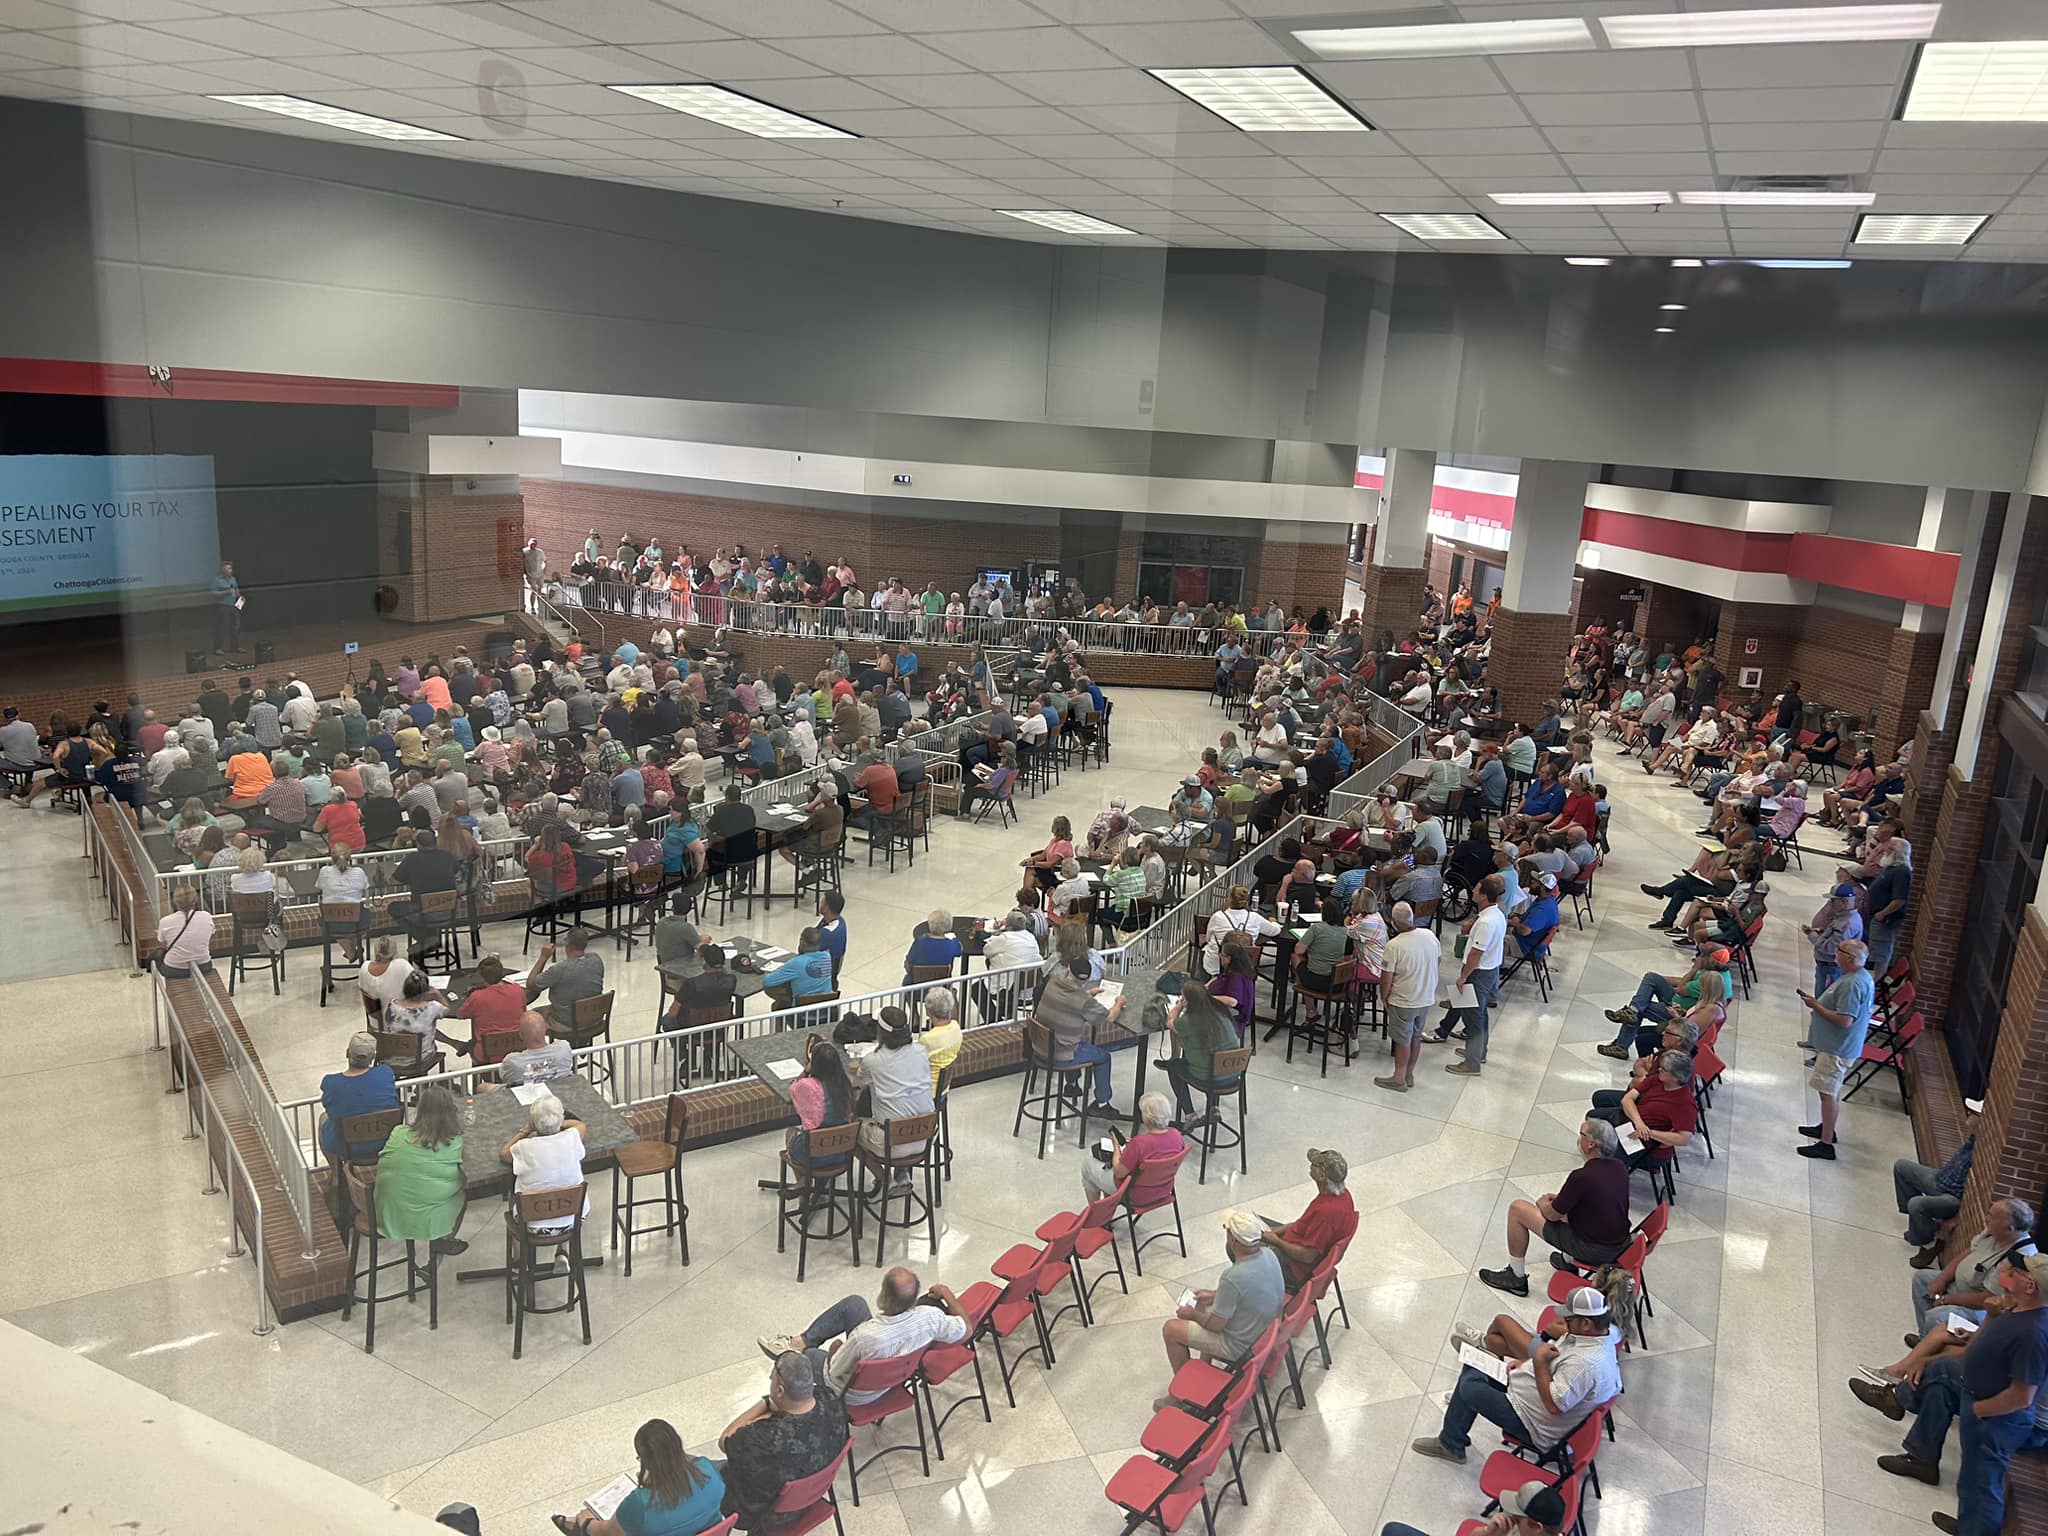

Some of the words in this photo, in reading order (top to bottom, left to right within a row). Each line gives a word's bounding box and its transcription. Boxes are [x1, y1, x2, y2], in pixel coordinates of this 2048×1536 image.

[91, 502, 143, 519] YOUR
[148, 501, 181, 517] TAX
[0, 526, 96, 547] SESMENT
[1222, 1056, 1248, 1069] CHS
[354, 1119, 391, 1134] CHS
[899, 1122, 929, 1137] CHS
[820, 1135, 850, 1148] CHS
[534, 1199, 573, 1212] CHS
